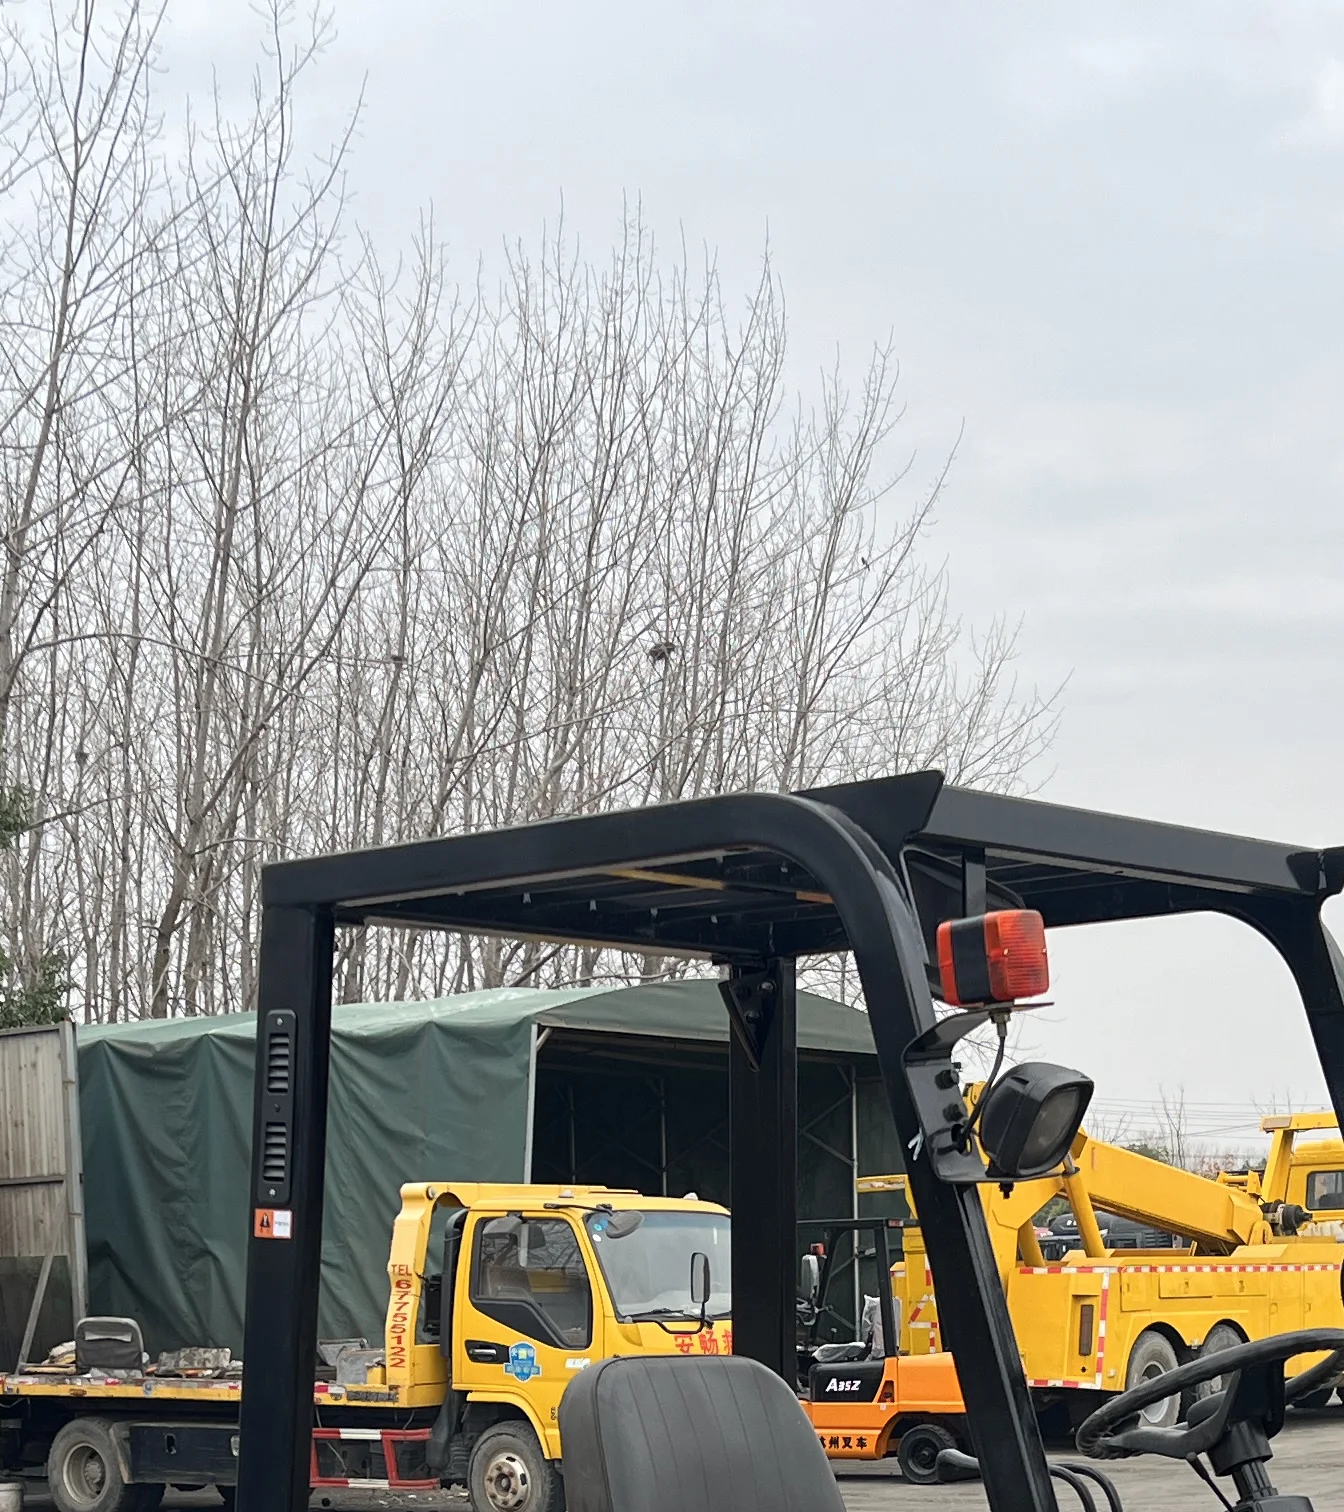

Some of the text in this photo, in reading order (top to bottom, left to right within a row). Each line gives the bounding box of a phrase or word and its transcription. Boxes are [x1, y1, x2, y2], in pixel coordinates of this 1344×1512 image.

[389, 1264, 412, 1369] TEL 67755122
[825, 1378, 862, 1392] A35Z
